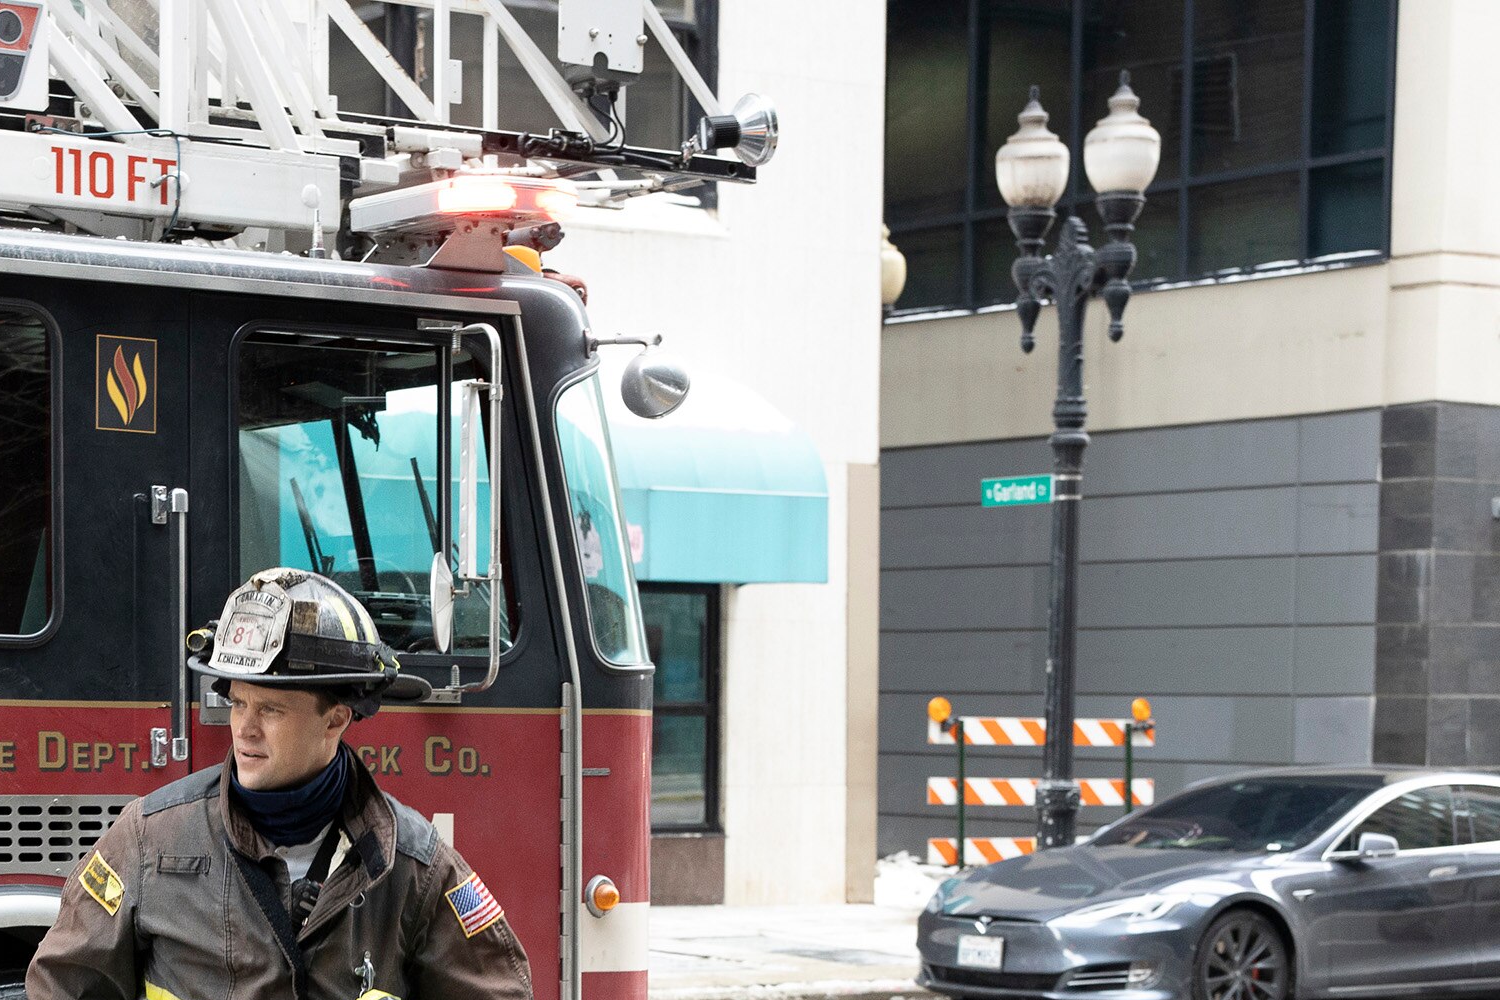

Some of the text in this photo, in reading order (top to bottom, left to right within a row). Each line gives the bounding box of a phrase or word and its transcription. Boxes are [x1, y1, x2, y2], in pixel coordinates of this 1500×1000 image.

[51, 146, 177, 206] 110 FT
[232, 626, 255, 646] 81
[38, 730, 151, 772] DEPT.
